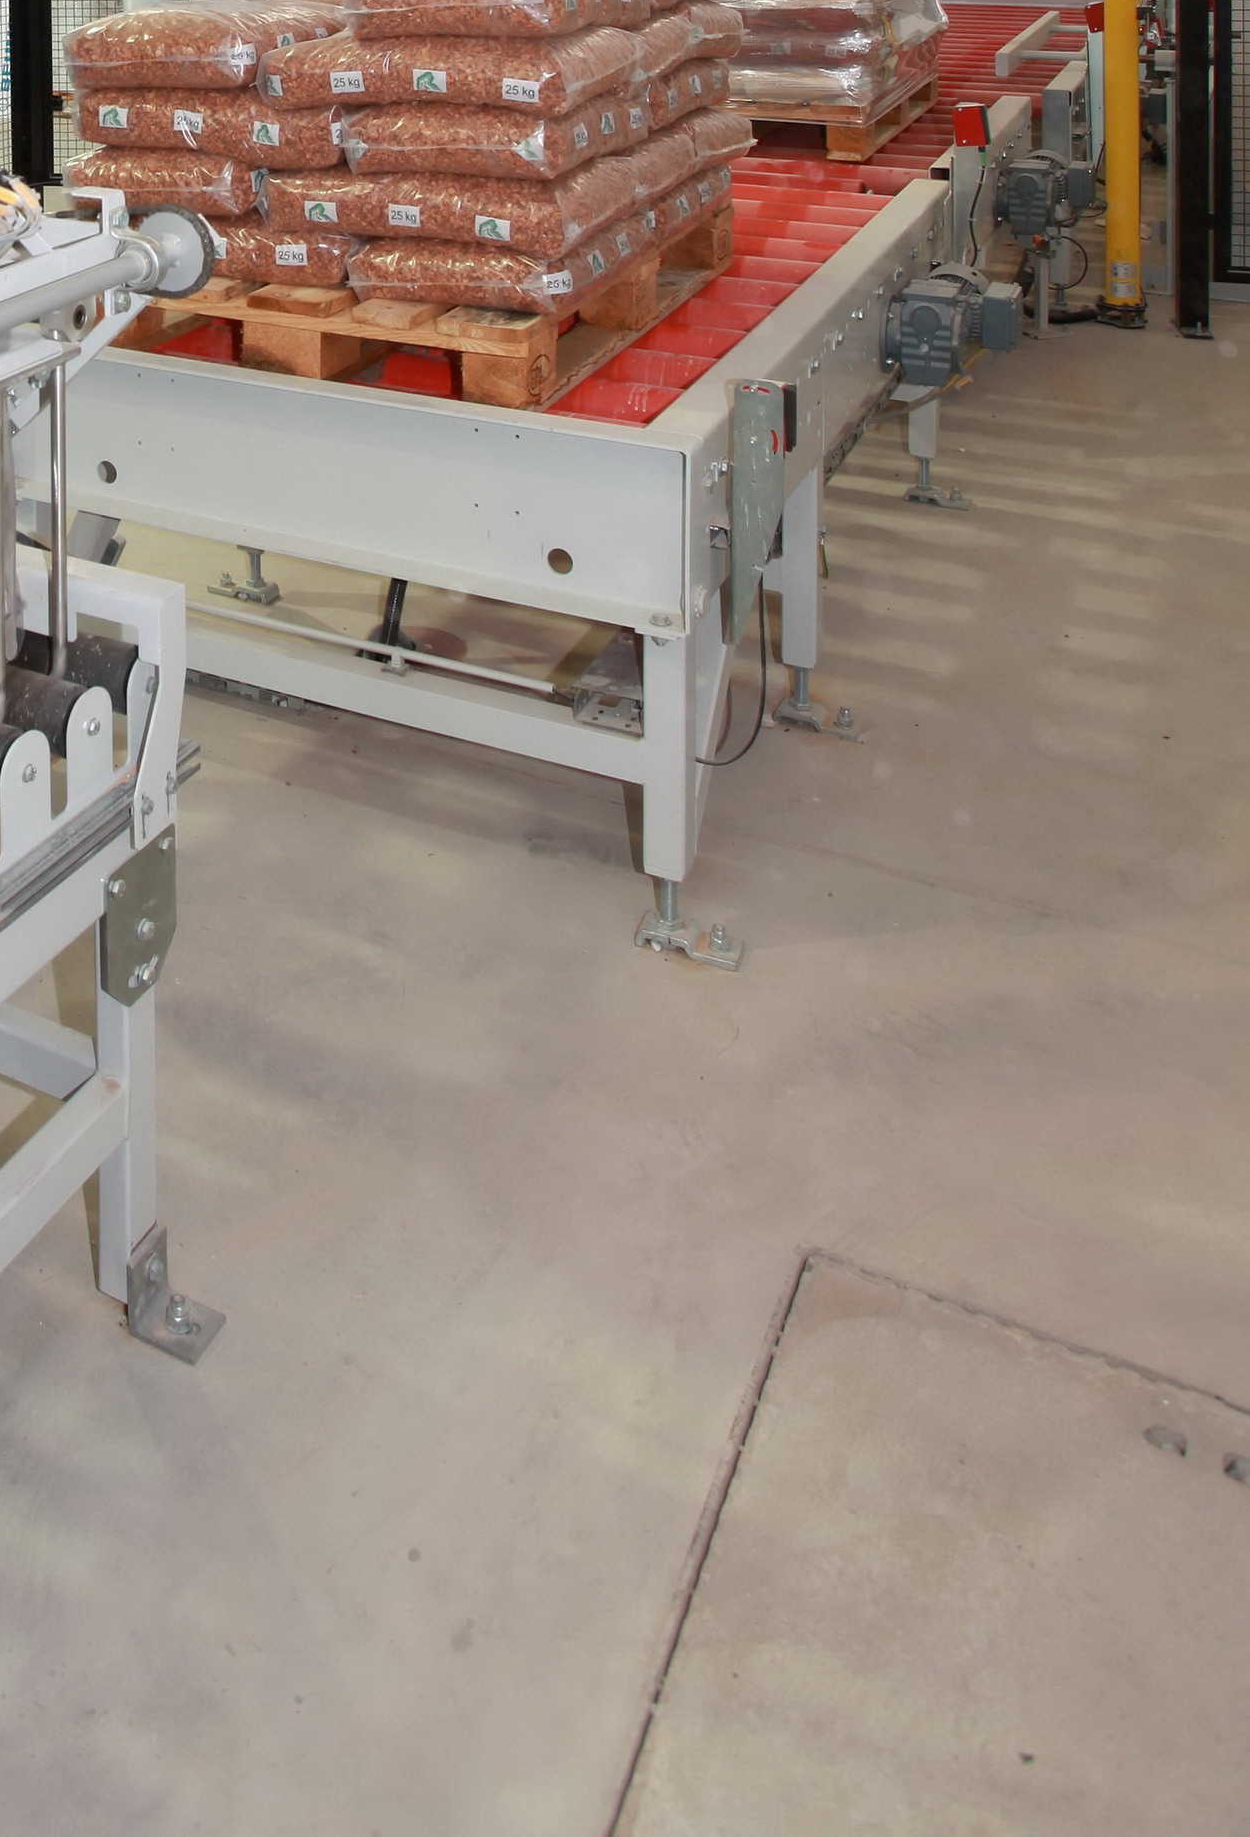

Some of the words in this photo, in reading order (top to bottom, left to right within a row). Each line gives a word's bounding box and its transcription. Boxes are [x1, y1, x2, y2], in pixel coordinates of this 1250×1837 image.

[333, 77, 346, 88] 25
[347, 76, 361, 89] kg
[505, 84, 519, 95] 25
[522, 86, 535, 99] kg
[189, 118, 200, 131] kg
[391, 210, 403, 221] 25
[405, 210, 417, 224] kg
[278, 250, 290, 261] 25
[291, 250, 304, 263] kg
